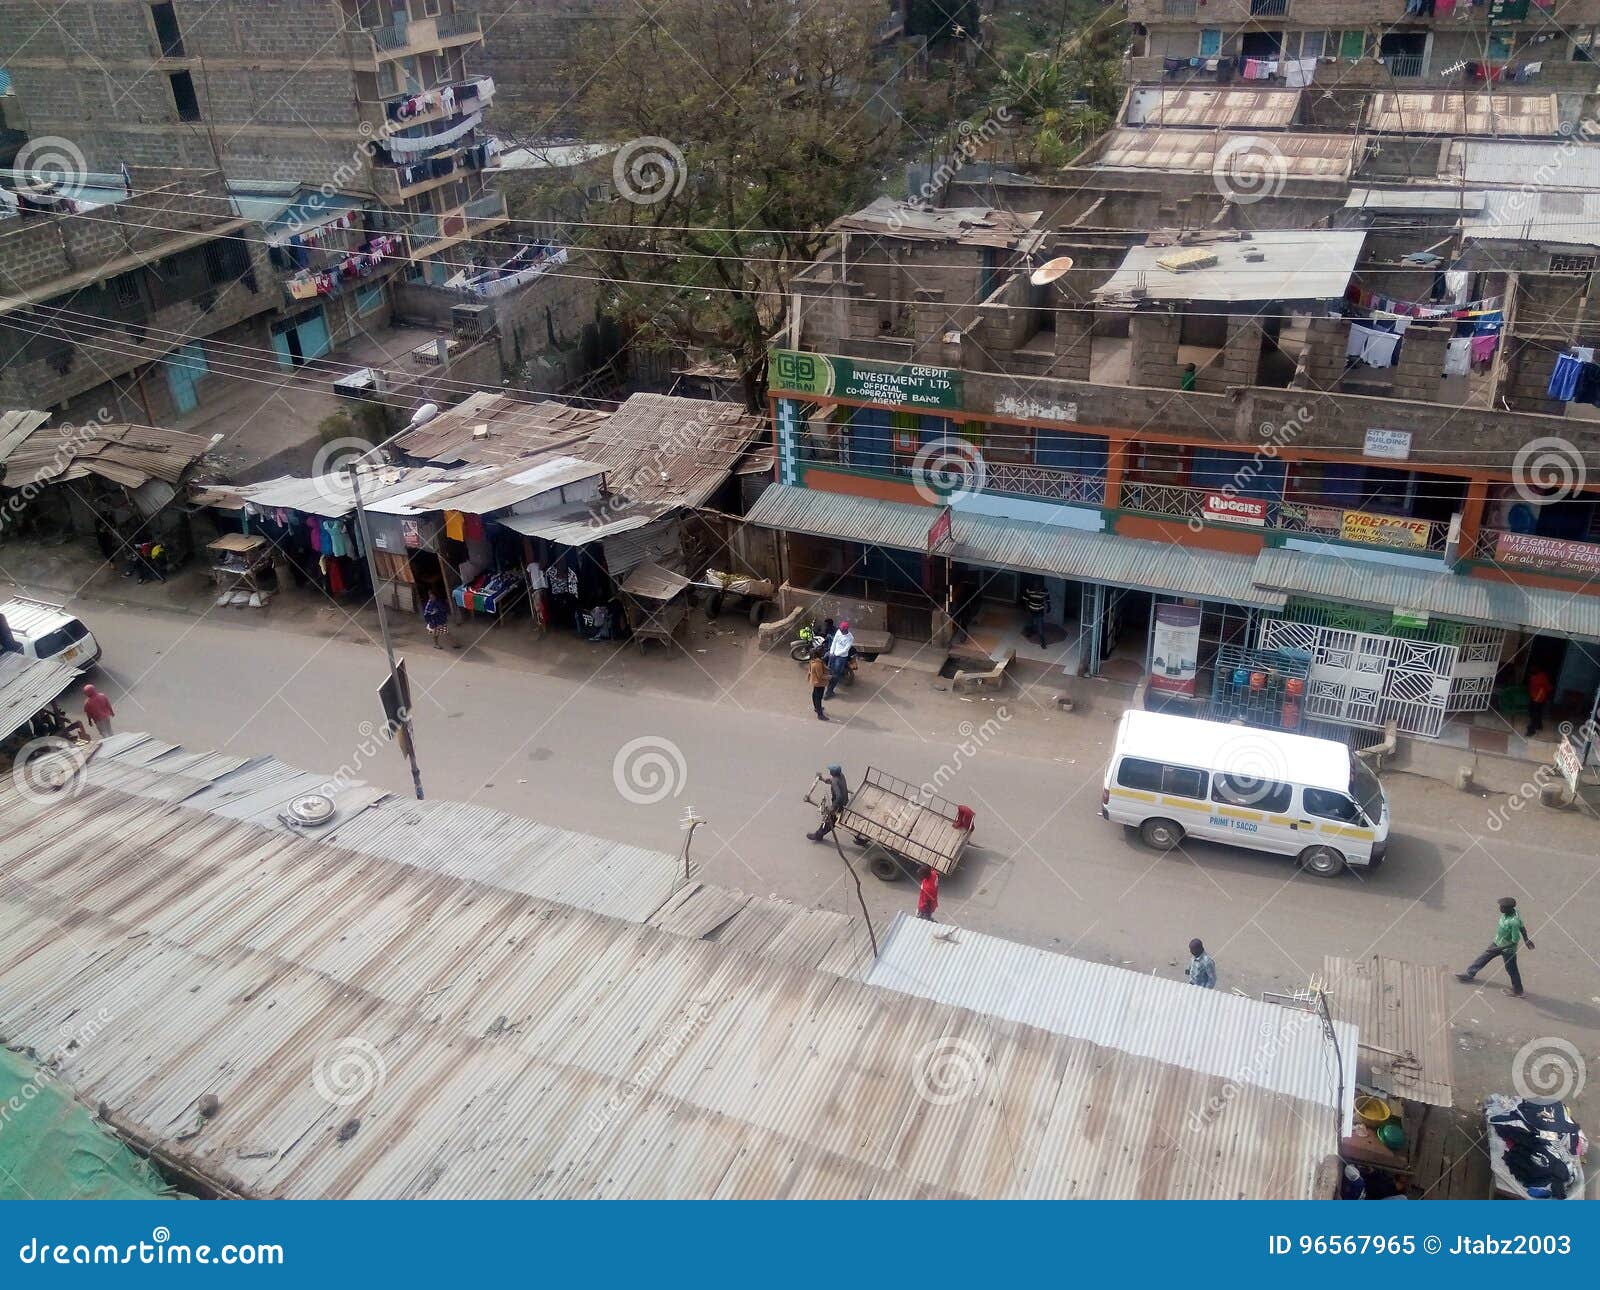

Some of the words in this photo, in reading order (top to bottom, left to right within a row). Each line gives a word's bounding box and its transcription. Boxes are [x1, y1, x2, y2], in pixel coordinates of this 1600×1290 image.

[852, 370, 925, 387] INVESTMENT
[929, 379, 952, 390] LTD.
[911, 366, 949, 379] CREDIT
[846, 387, 908, 401] CO-OPERATIVE
[912, 394, 940, 404] BANK
[863, 382, 902, 393] OFFICIAL
[872, 397, 903, 406] AGENT
[1367, 436, 1408, 446] BUILDING
[1209, 496, 1262, 514] HUGGIES
[1344, 514, 1389, 528] CYBER
[1503, 534, 1567, 550] INTEGRITY
[1510, 543, 1565, 560] INFORMATION
[1503, 552, 1518, 562] For
[1520, 555, 1534, 564] all
[1536, 558, 1558, 568] your
[1209, 816, 1228, 827] PRIME
[1236, 821, 1258, 832] SACCO
